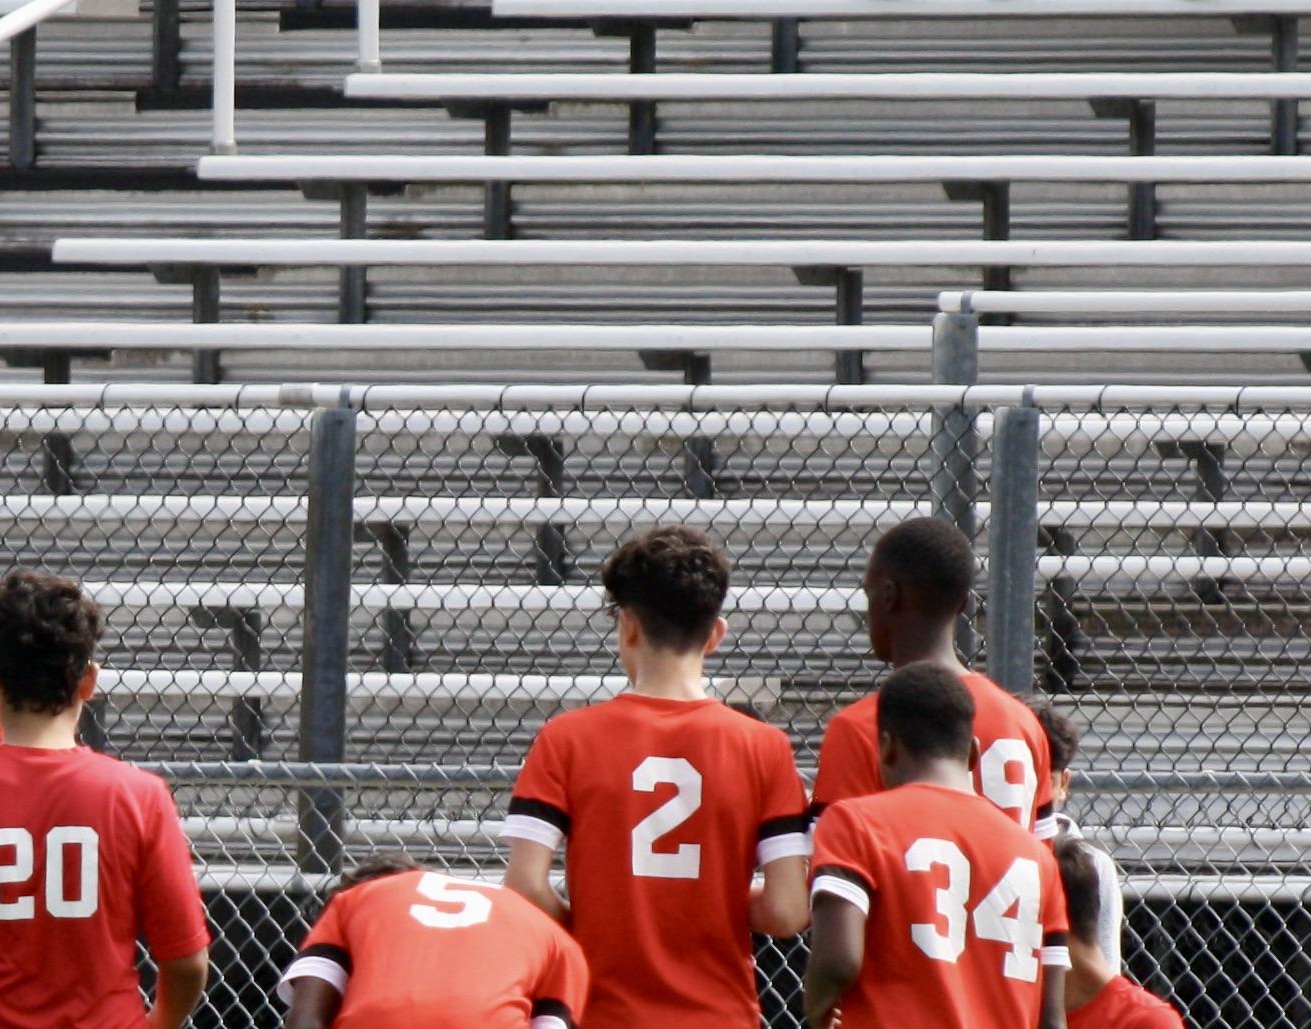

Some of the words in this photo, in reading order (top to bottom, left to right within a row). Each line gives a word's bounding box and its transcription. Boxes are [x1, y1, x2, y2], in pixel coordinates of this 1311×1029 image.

[631, 756, 703, 879] 2
[409, 871, 504, 928] 5
[904, 837, 1043, 984] 34
